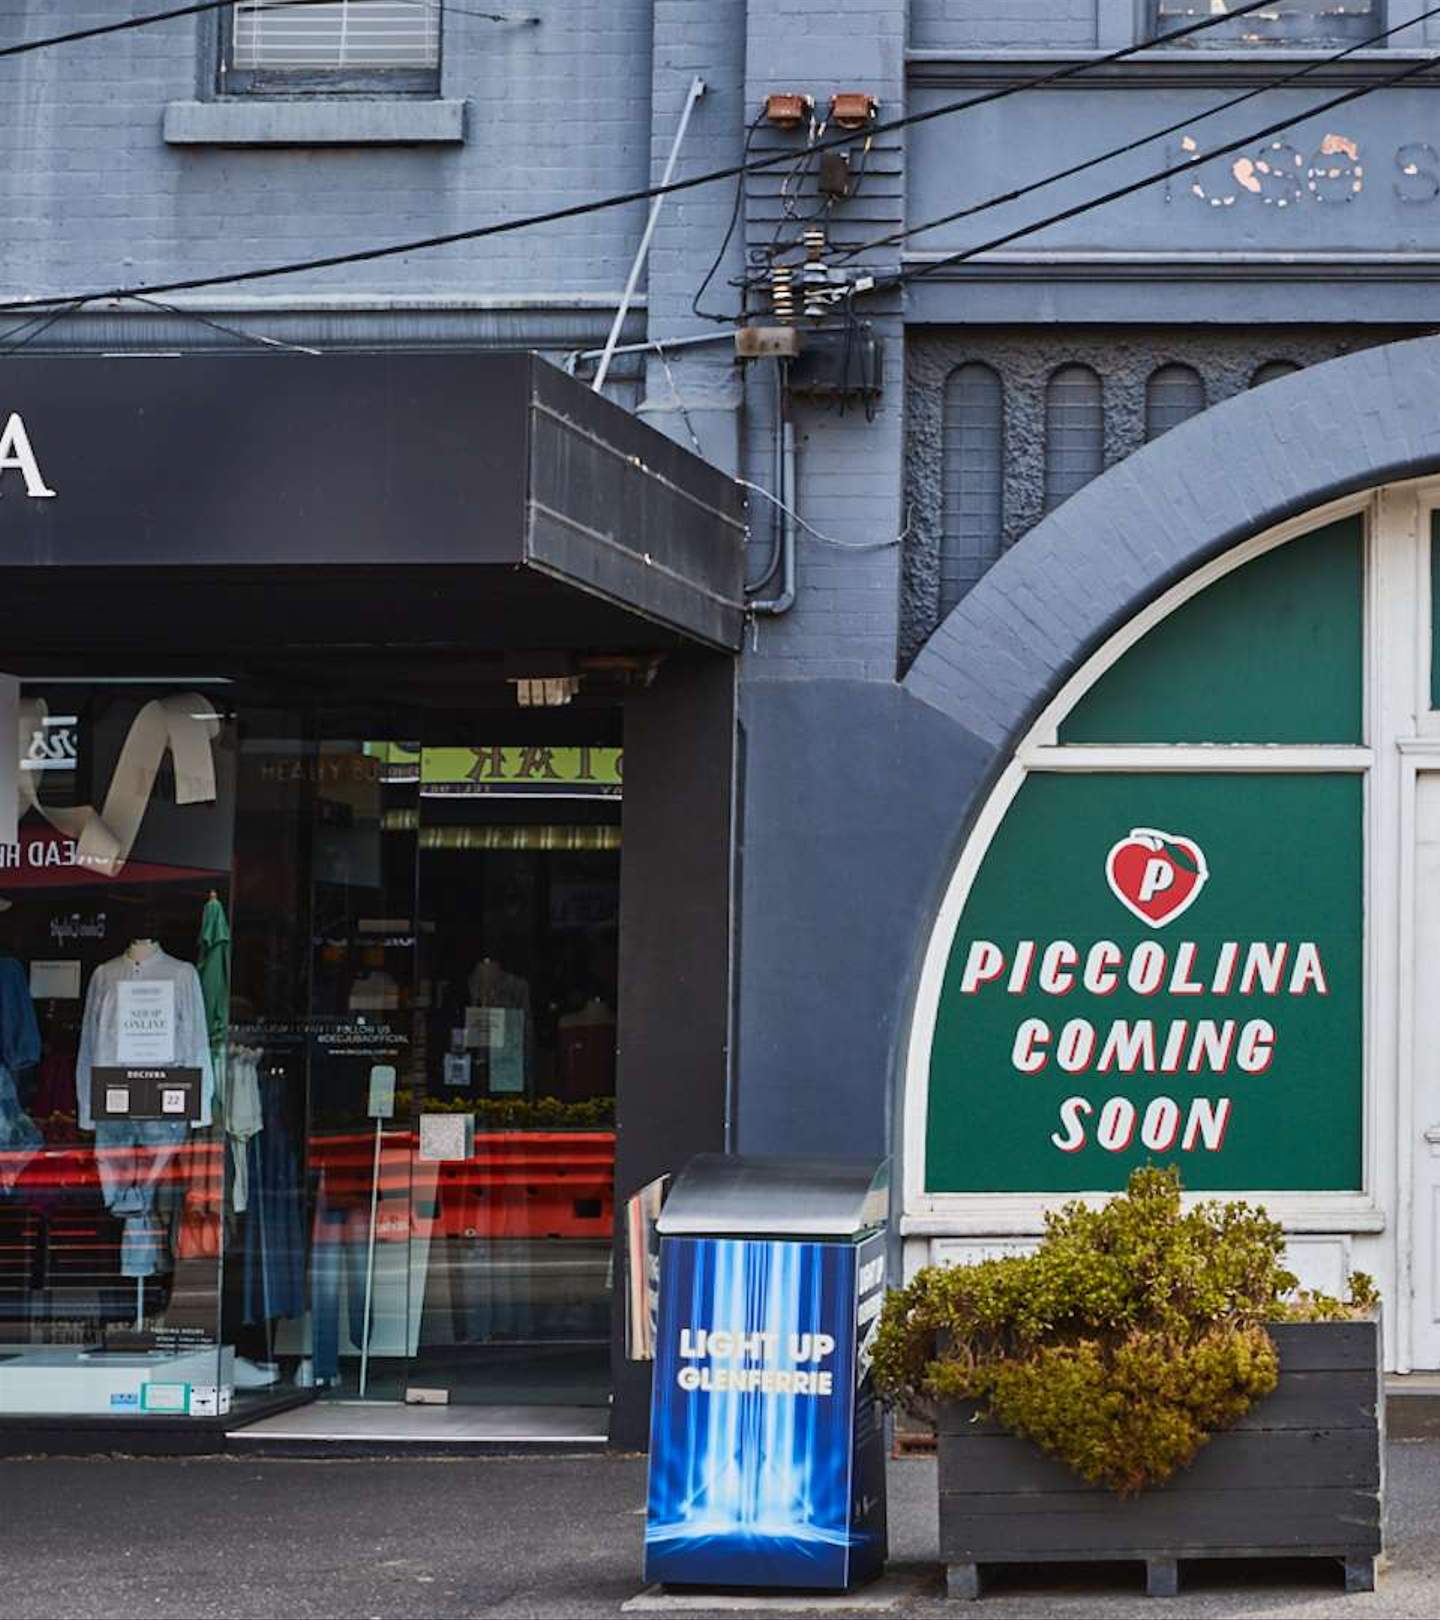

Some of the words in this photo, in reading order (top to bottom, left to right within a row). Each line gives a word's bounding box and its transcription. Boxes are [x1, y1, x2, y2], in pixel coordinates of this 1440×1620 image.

[1138, 858, 1175, 901] P
[960, 940, 1328, 996] PICCOLINA
[1011, 1018, 1277, 1075] COMING
[1051, 1096, 1231, 1152] SOON
[680, 1328, 779, 1361] LIGHT
[787, 1333, 835, 1364] UP
[677, 1366, 833, 1395] GLENFERRIE
